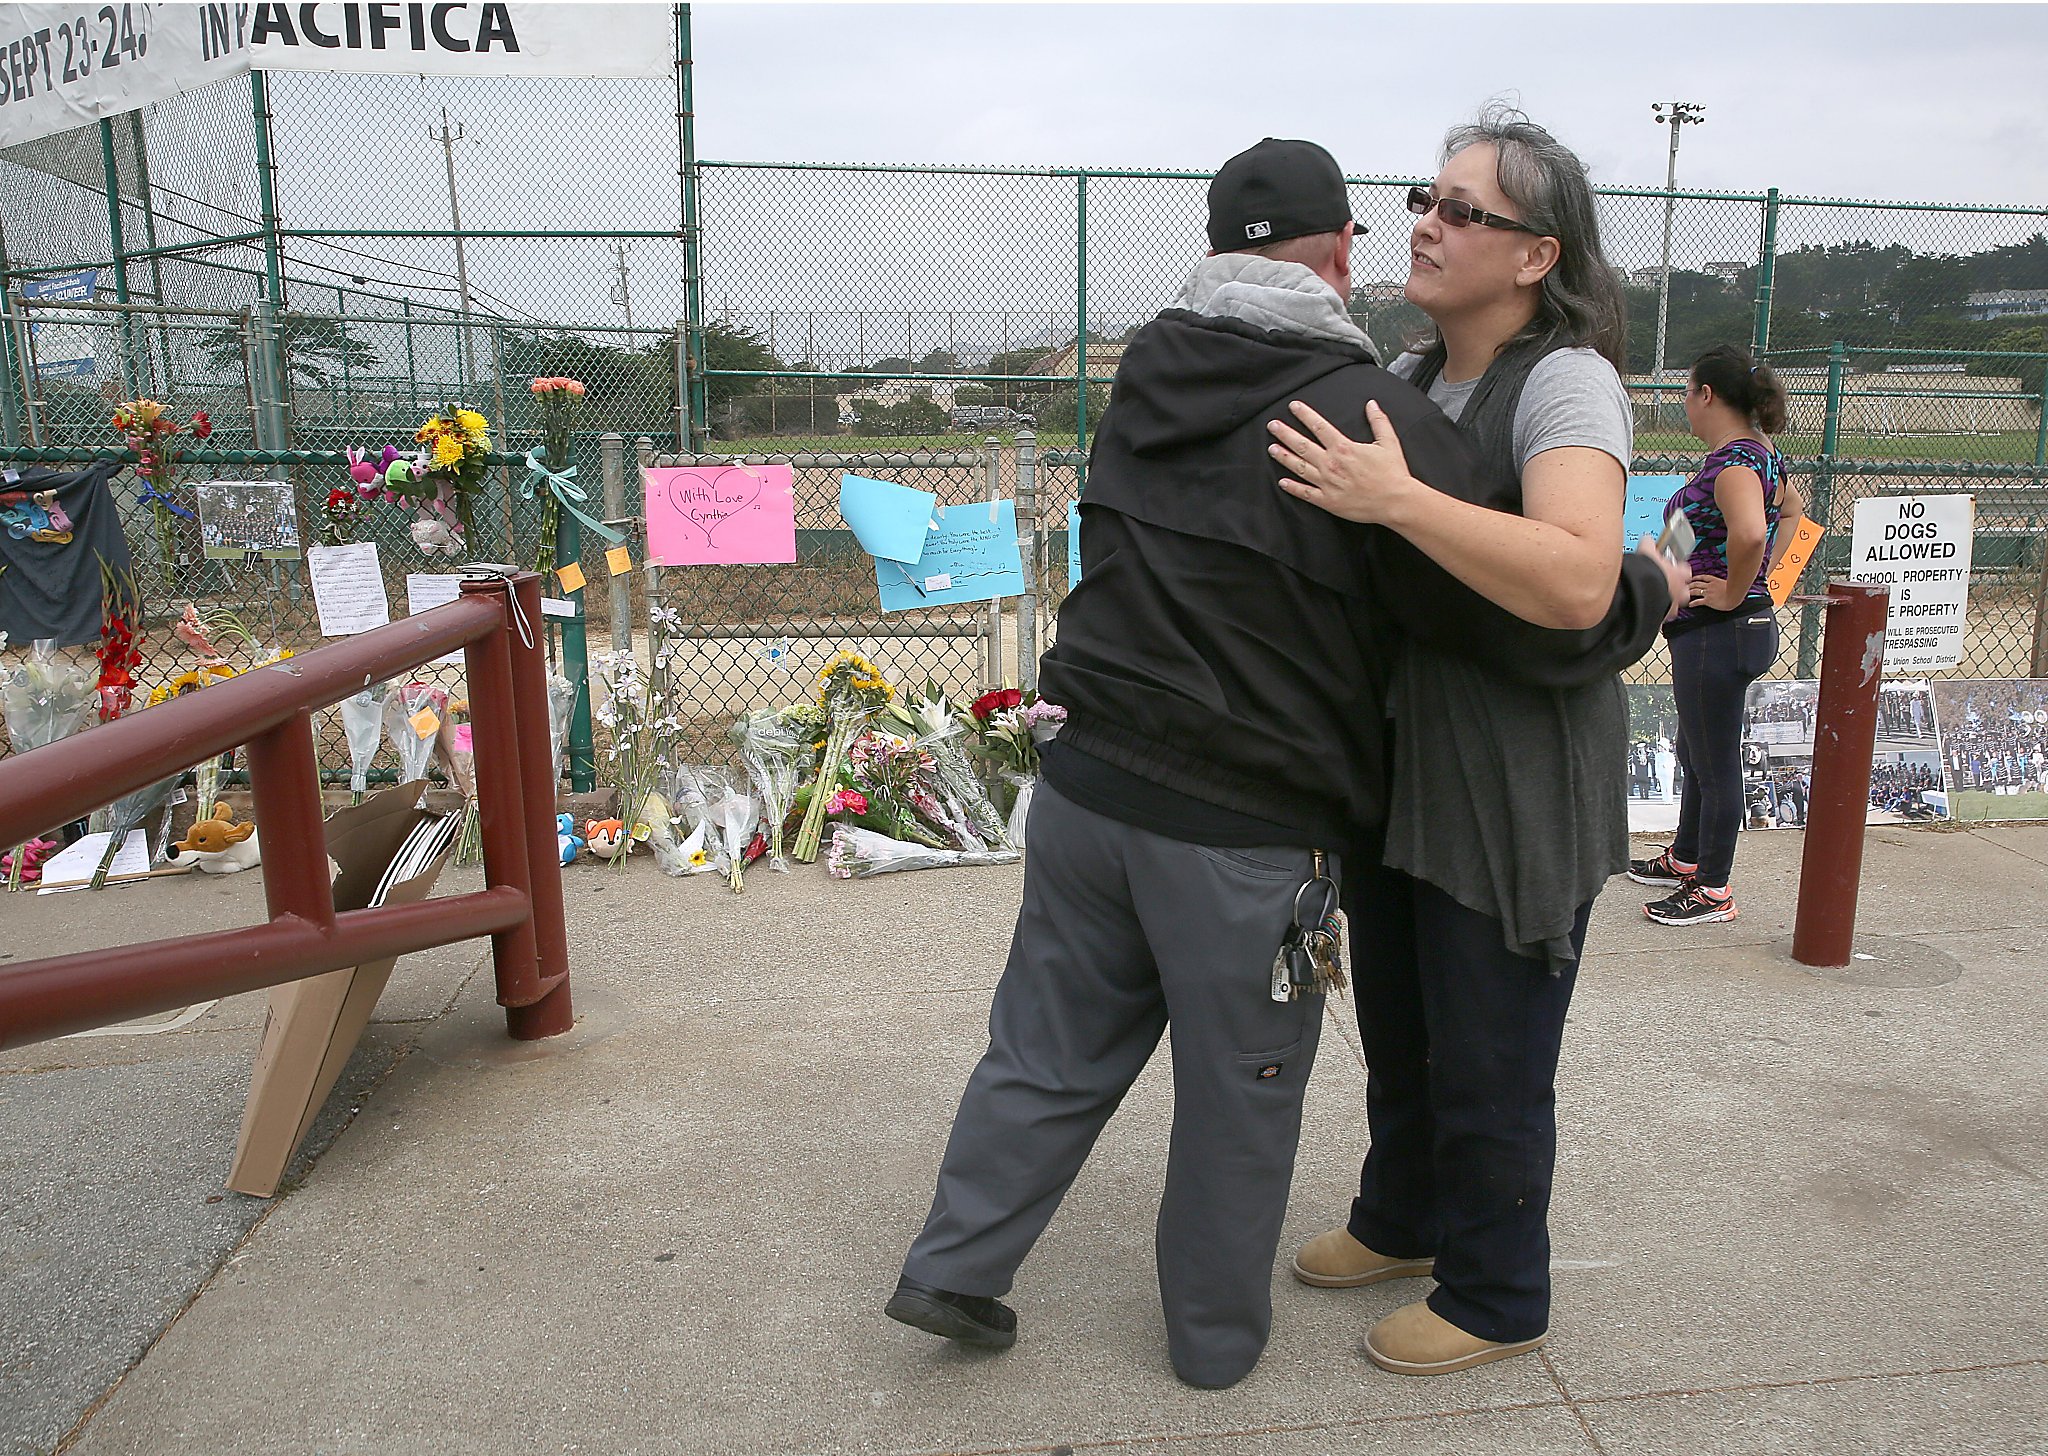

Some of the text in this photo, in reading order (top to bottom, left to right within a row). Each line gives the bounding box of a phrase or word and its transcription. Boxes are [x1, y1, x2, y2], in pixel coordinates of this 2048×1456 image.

[199, 3, 230, 62] IN
[0, 28, 52, 106] SEPT
[679, 487, 743, 504] With Love
[690, 508, 729, 524] Cynthia
[1899, 502, 1925, 519] NO
[1885, 522, 1937, 541] DOGS
[1865, 542, 1956, 562] ALLOWED
[1856, 568, 1963, 584] SCHOOL PROPERTY
[1900, 588, 1911, 601] IS
[1900, 603, 1959, 617] PROPERTY
[1887, 625, 1959, 637] WILL BE PROSECUTED
[1885, 637, 1938, 650] TRESPASSING
[1893, 656, 1910, 666] Union
[1912, 655, 1933, 665] School
[1935, 654, 1957, 664] District
